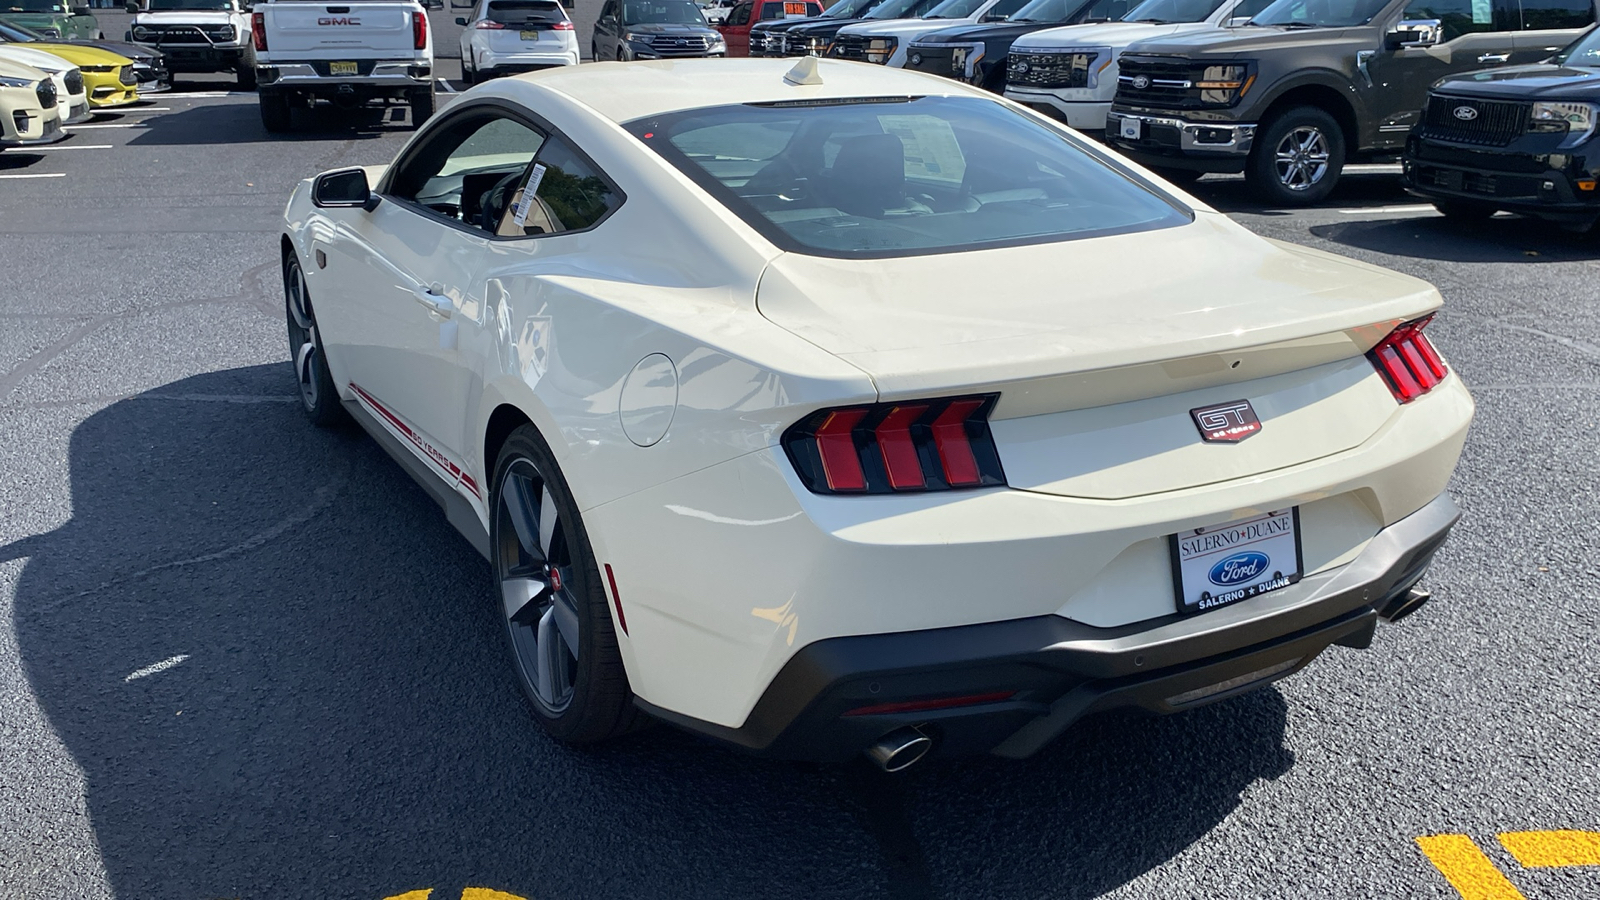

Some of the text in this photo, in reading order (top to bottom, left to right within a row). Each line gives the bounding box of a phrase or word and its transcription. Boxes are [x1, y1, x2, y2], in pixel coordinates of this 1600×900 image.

[317, 17, 361, 26] GMC
[1198, 404, 1248, 430] GT
[412, 432, 449, 467] 60 YEARS
[1181, 517, 1290, 557] SALERNO DUANE
[1221, 556, 1259, 583] Ford
[1198, 576, 1291, 610] SALERNO DUANE
